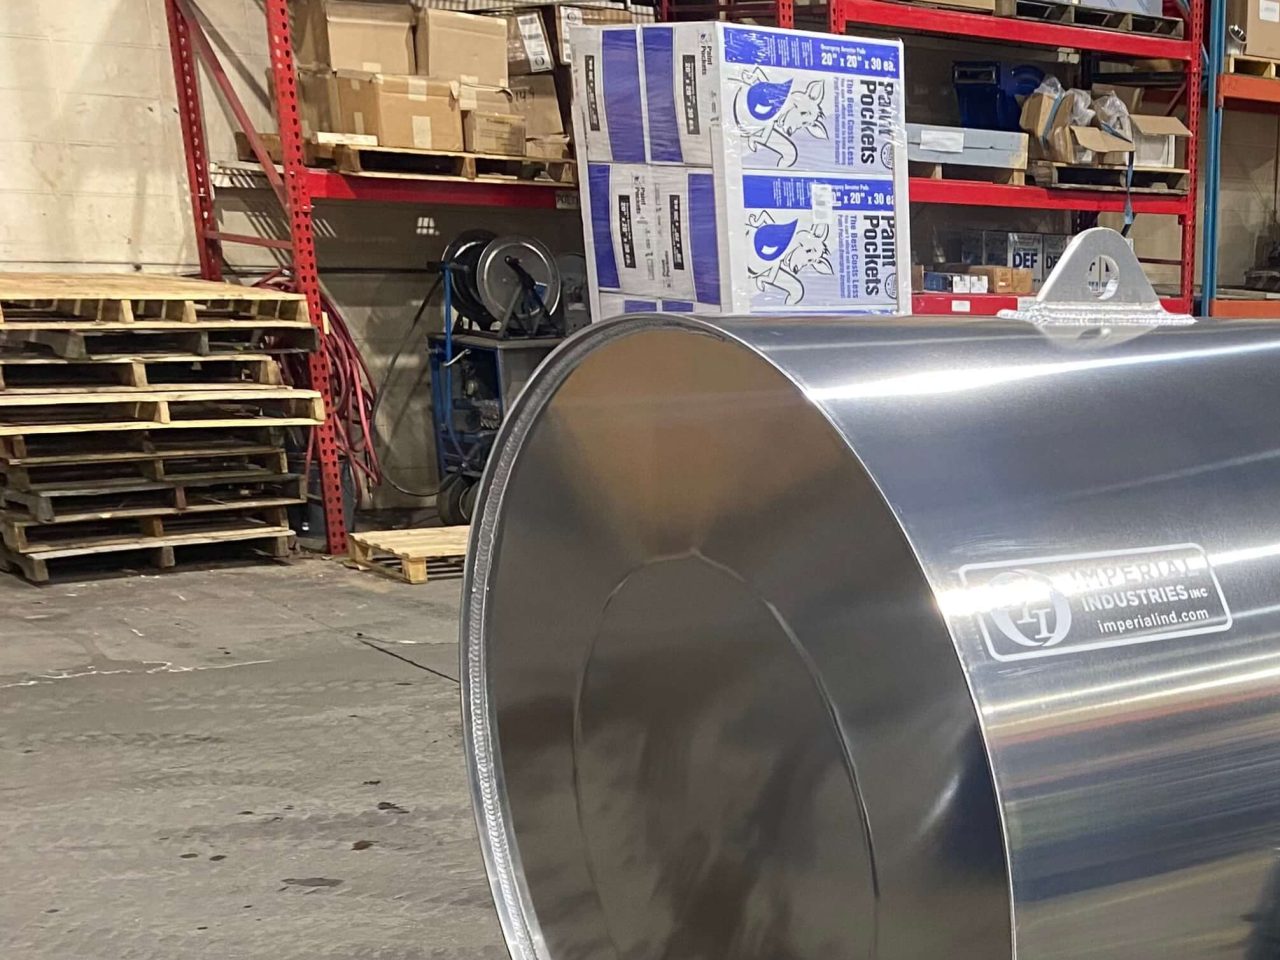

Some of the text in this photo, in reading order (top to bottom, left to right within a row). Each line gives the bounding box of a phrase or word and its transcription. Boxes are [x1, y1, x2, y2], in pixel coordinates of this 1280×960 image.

[821, 53, 838, 66] 20"
[840, 58, 845, 67] x
[847, 55, 862, 67] 20"
[864, 61, 870, 69] x
[871, 58, 882, 70] 30
[847, 120, 855, 144] Costs
[860, 80, 877, 164] Pockets
[850, 192, 865, 204] 20"
[874, 193, 884, 205] 30
[881, 215, 896, 267] Paint
[864, 215, 881, 296] Pockets
[1012, 253, 1038, 268] DEF
[1046, 256, 1060, 269] DE
[1081, 585, 1188, 612] INDUSTRIES
[1097, 608, 1210, 634] imperialind.com
